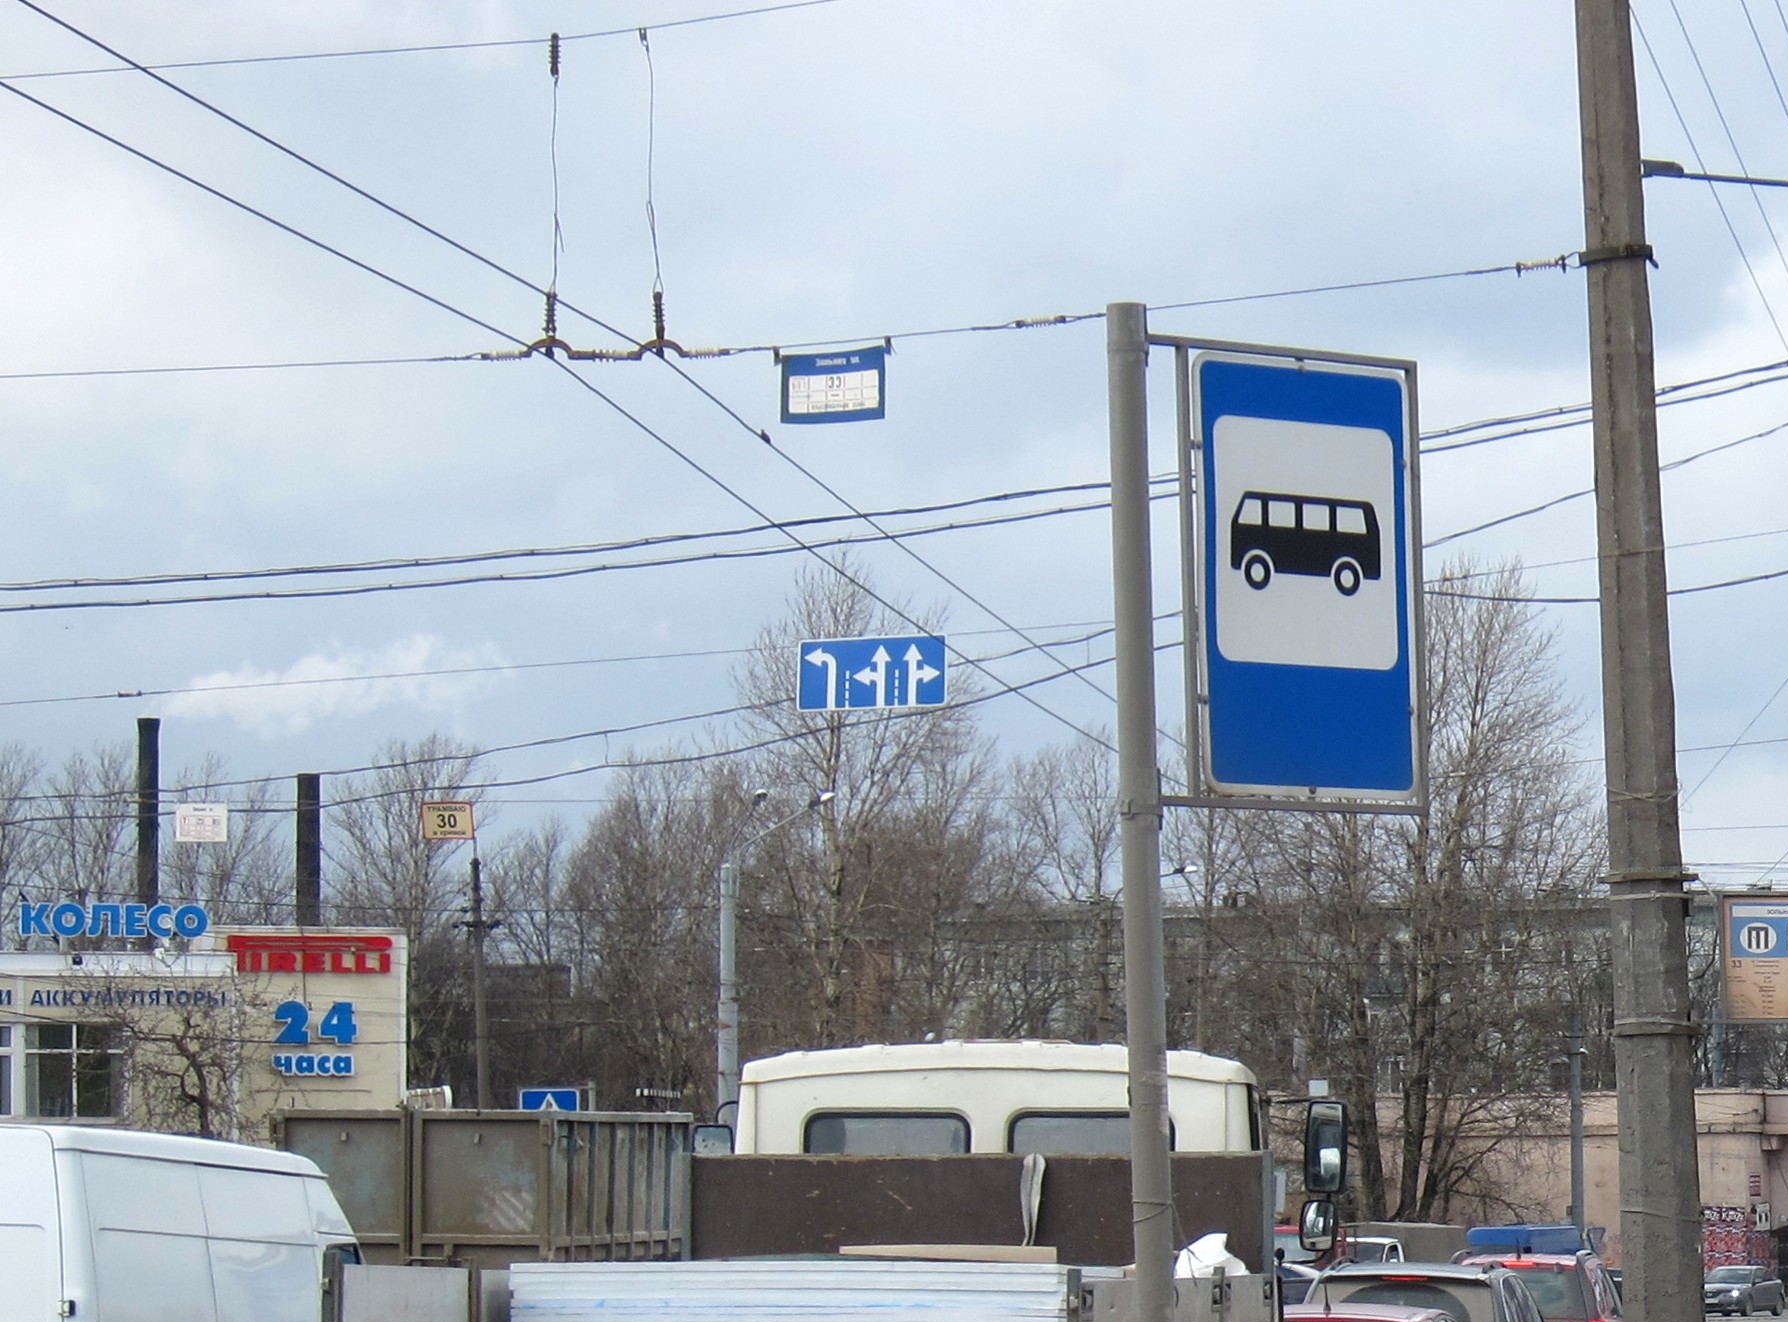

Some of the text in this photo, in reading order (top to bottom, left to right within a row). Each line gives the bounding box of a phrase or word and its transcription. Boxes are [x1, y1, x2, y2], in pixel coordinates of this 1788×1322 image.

[437, 813, 457, 829] 30
[20, 902, 209, 939] КОЛЕСО
[227, 935, 393, 973] PIRELLI
[273, 1001, 358, 1045] 24
[272, 1054, 353, 1076] часа
